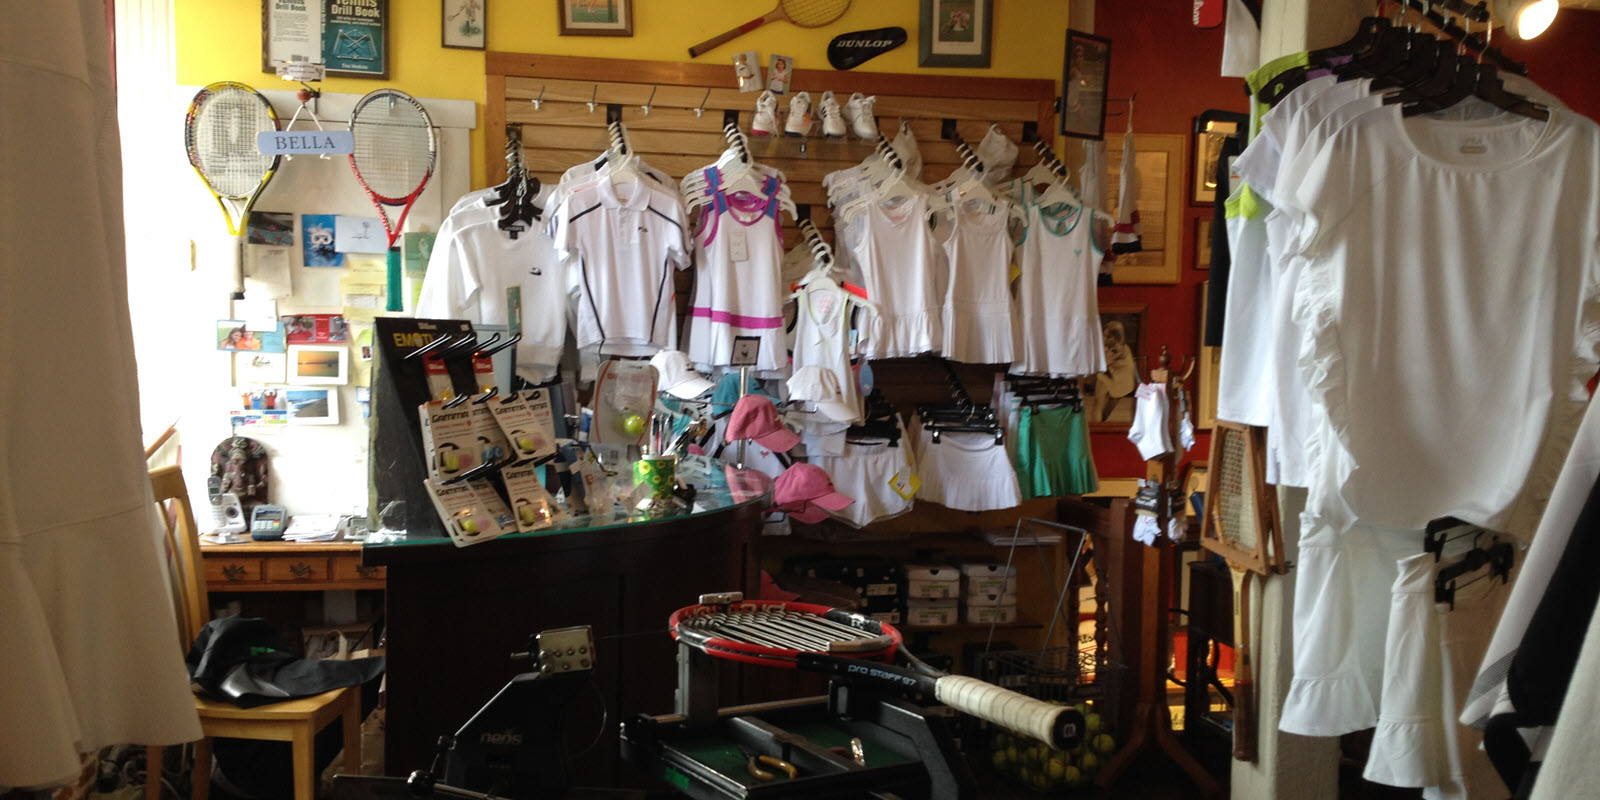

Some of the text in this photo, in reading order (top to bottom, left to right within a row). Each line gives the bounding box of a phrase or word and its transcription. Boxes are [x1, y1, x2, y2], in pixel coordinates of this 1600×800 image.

[331, 4, 380, 17] Drill Book
[836, 40, 893, 48] DUNLOP
[275, 136, 336, 150] BELLA
[847, 664, 868, 674] pro
[902, 676, 917, 686] 97
